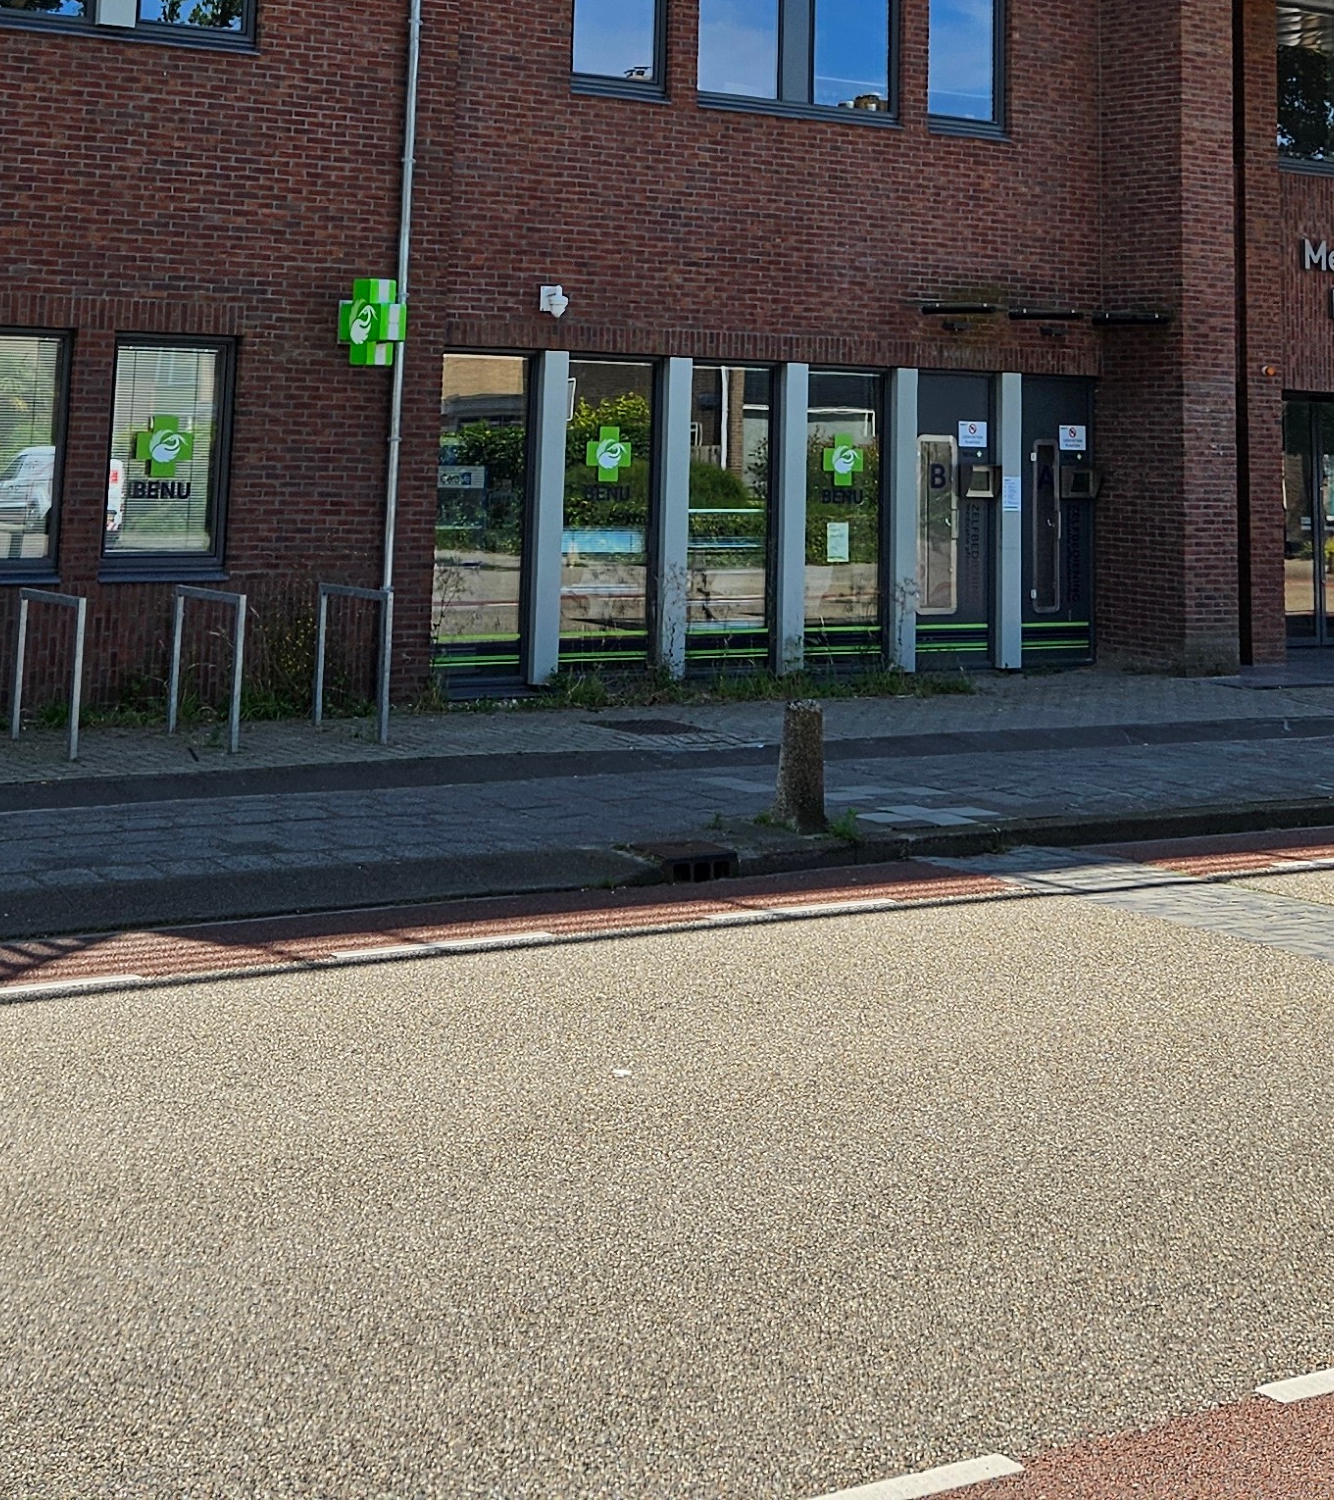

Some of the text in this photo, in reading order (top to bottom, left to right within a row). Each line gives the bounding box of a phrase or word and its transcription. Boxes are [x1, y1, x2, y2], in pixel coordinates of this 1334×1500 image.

[930, 463, 946, 489] B
[131, 481, 191, 499] BENU
[585, 484, 631, 501] BENU
[821, 489, 863, 504] BENU
